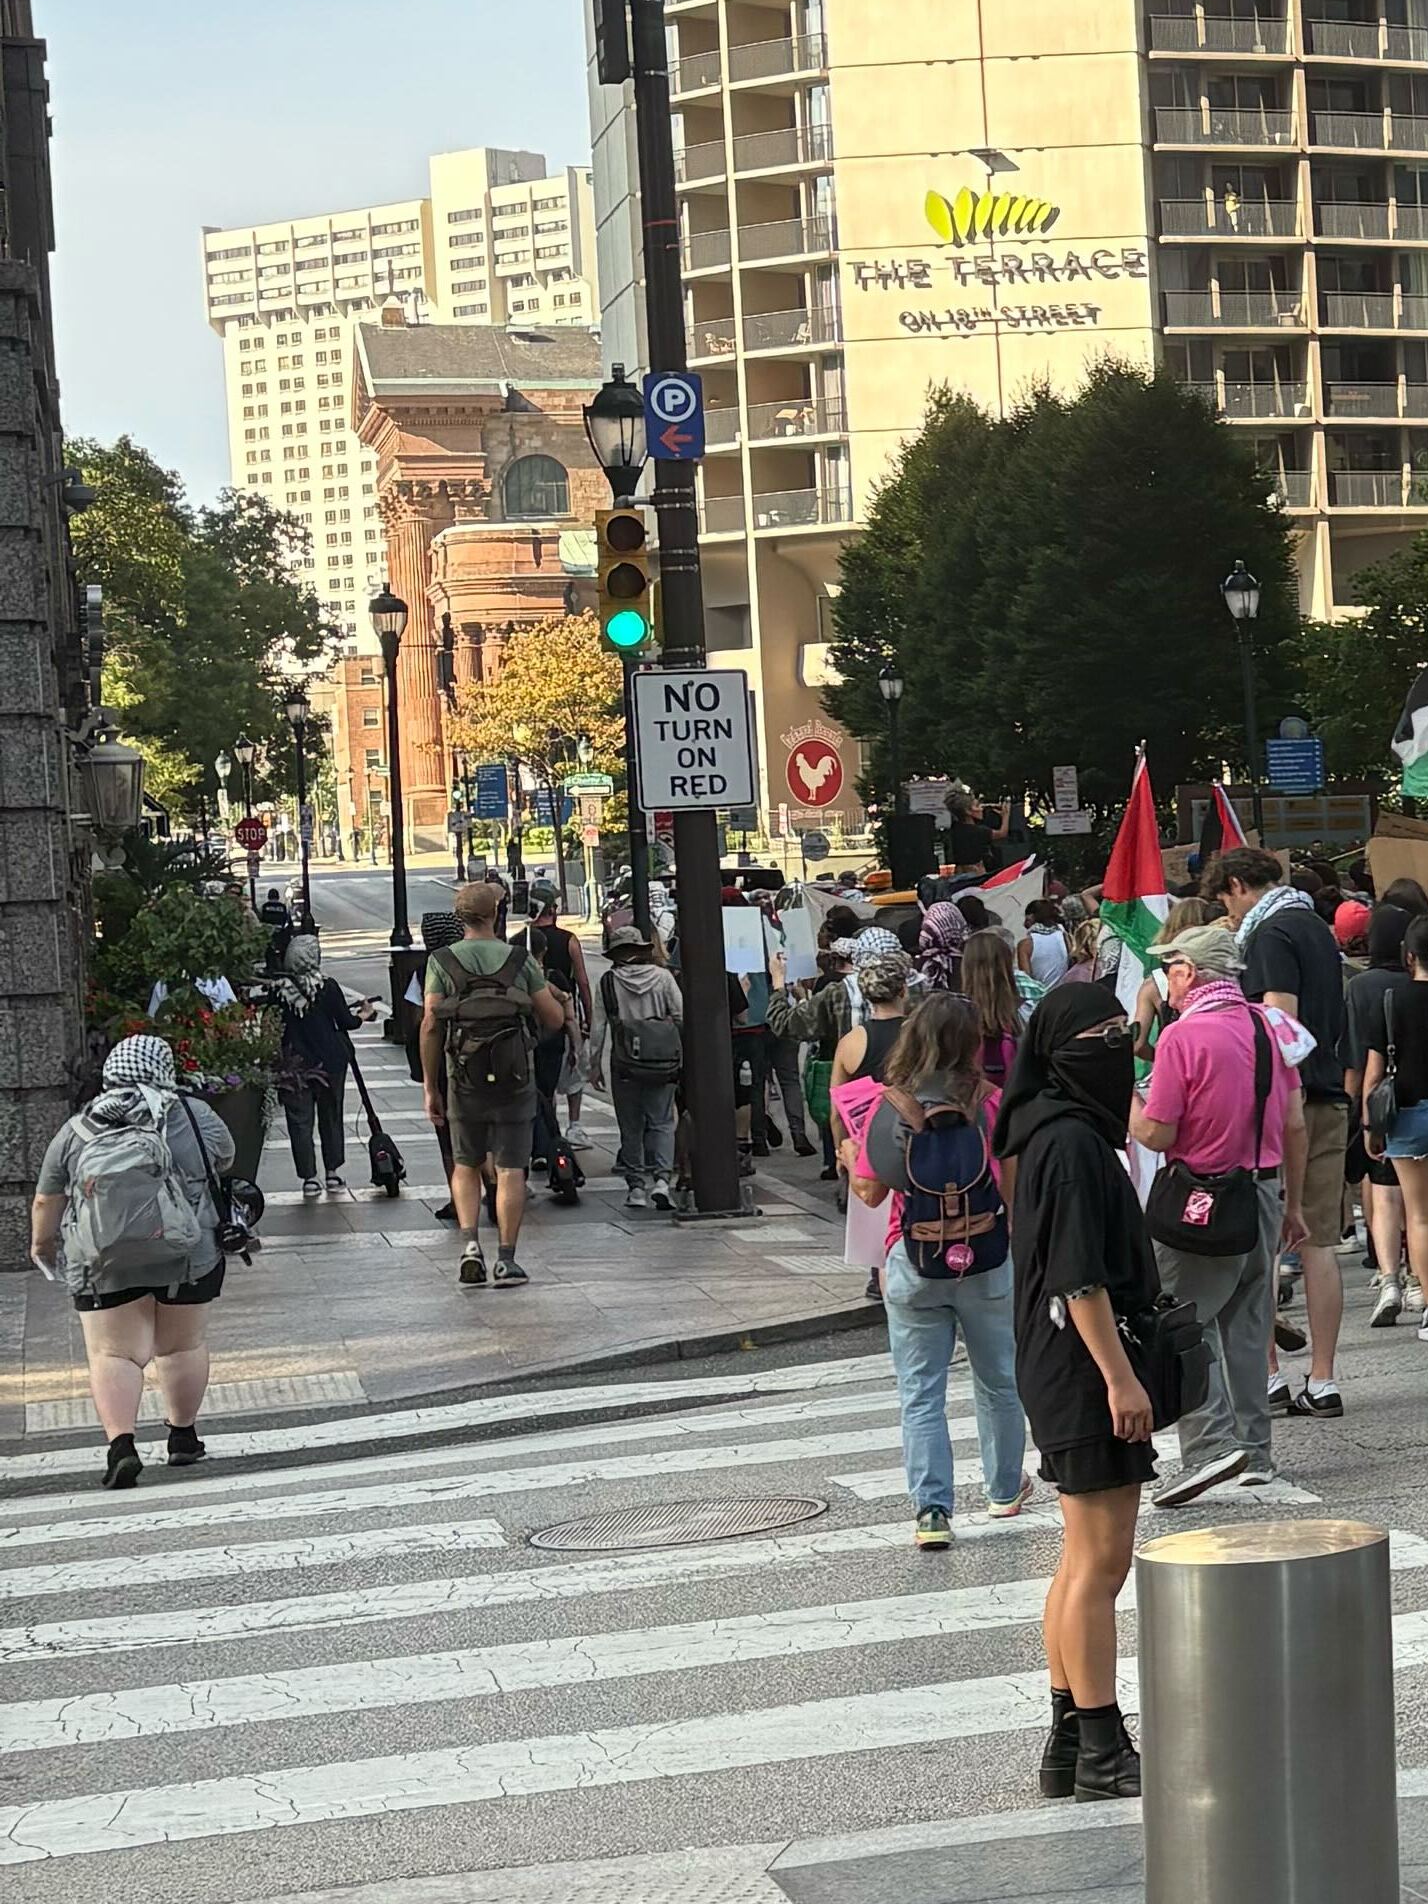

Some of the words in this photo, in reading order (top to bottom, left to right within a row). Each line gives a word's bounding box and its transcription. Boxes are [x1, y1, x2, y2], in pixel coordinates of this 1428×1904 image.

[846, 258, 932, 291] THE
[944, 248, 1149, 287] TERRACE
[899, 309, 941, 333] ON
[1000, 303, 1104, 328] STREET
[664, 387, 686, 413] P
[664, 682, 721, 713] NO
[653, 719, 733, 742] TURN
[677, 746, 717, 769] ON
[670, 773, 728, 797] RED
[236, 827, 266, 841] STOP
